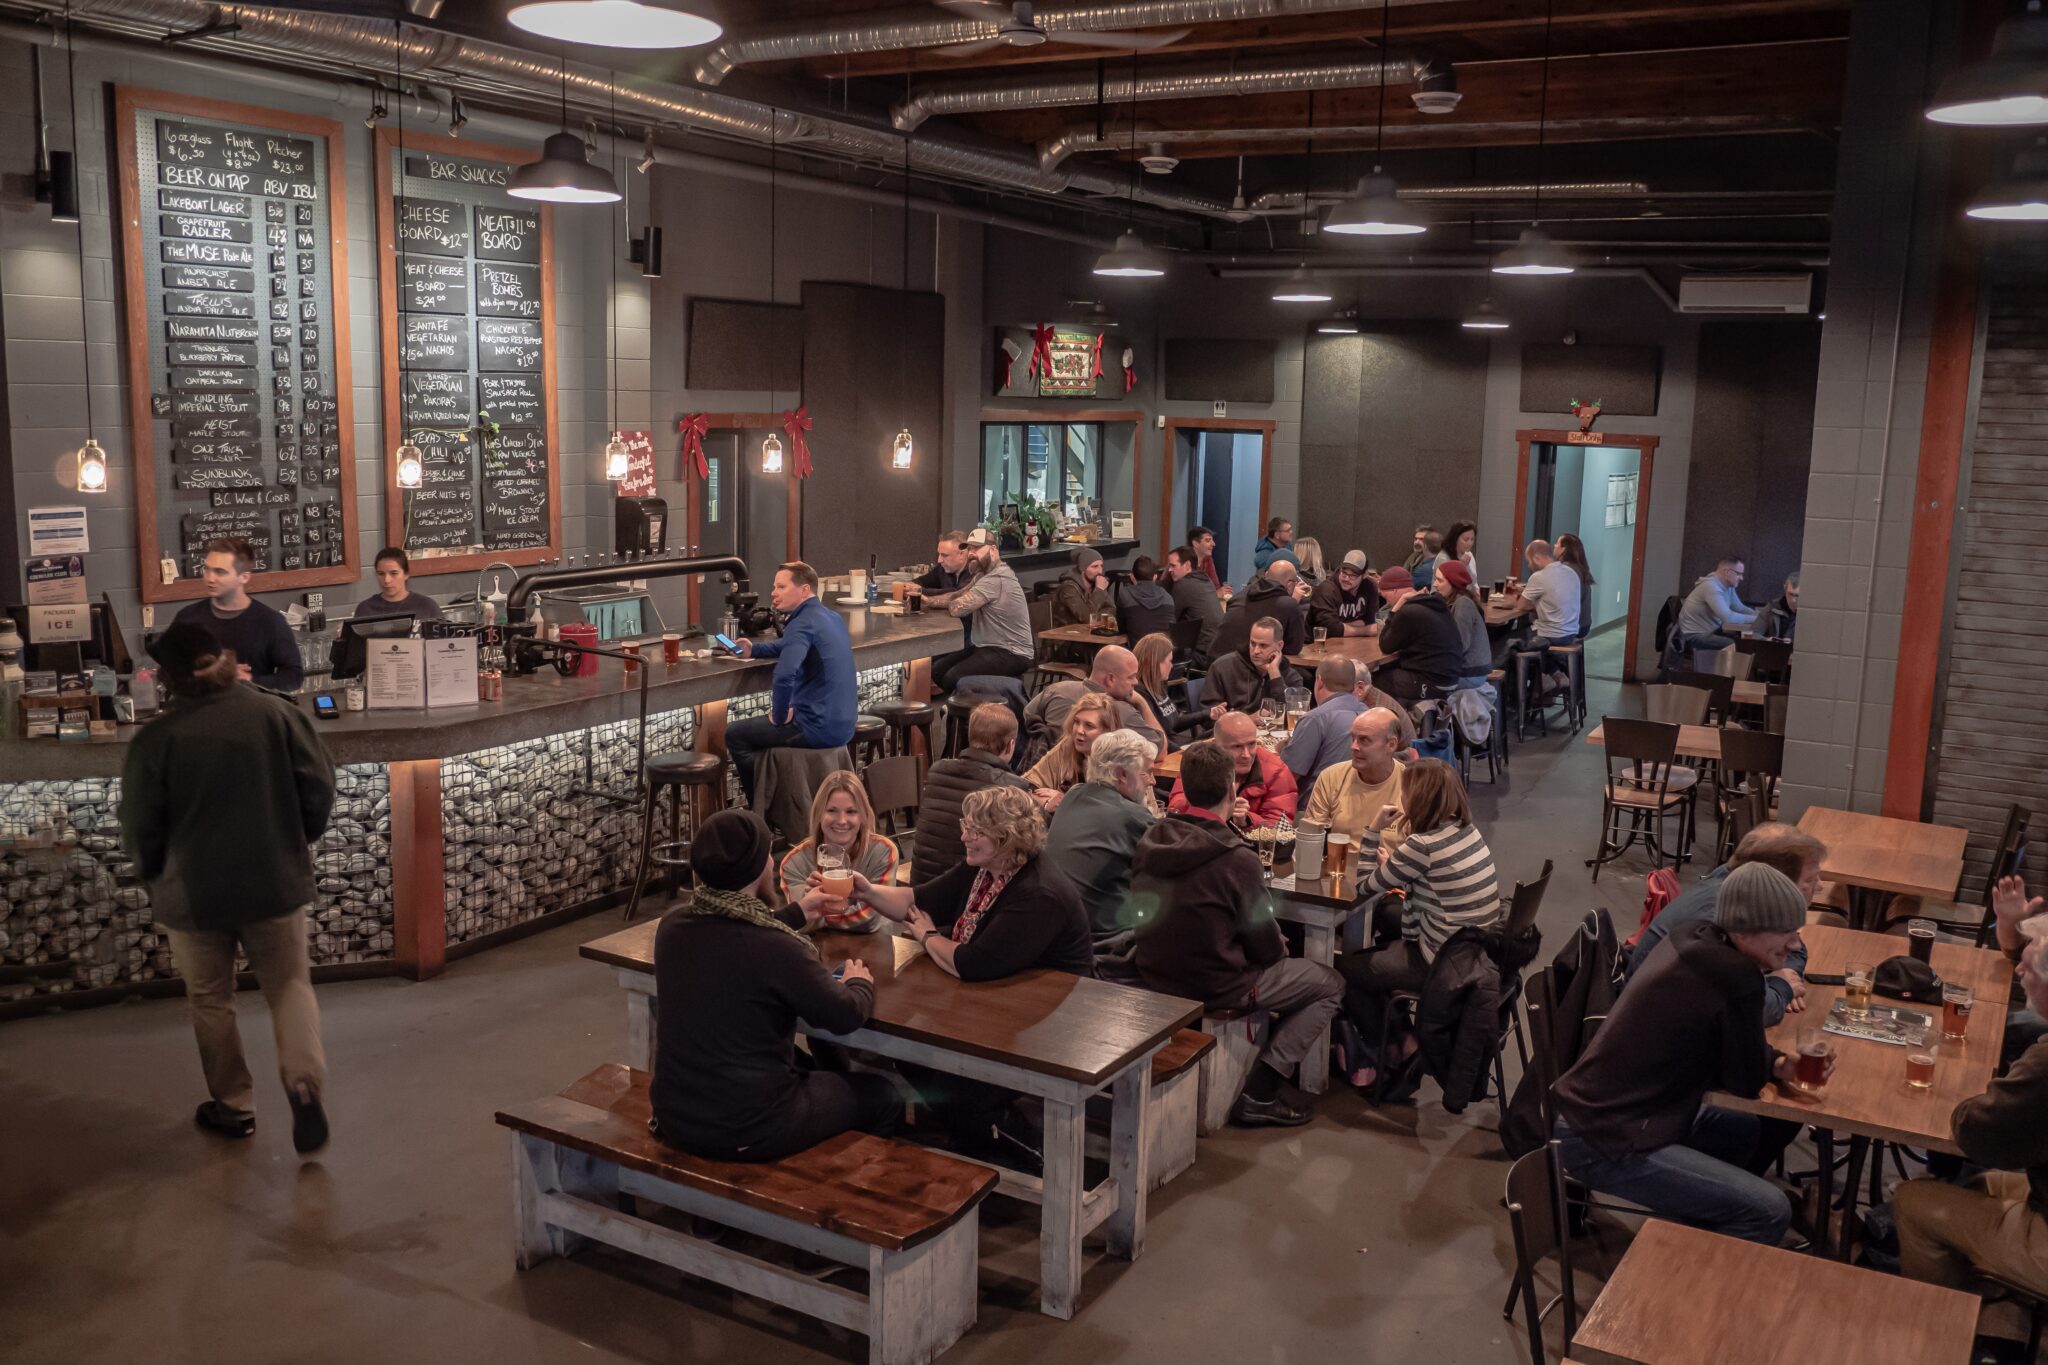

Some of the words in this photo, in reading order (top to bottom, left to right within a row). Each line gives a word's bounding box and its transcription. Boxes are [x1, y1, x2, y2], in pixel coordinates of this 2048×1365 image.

[165, 127, 176, 142] 16
[190, 134, 212, 147] glass
[225, 133, 254, 149] Flight
[267, 140, 302, 159] Pitcher
[272, 160, 304, 174] $23.00
[166, 166, 205, 186] BEER
[209, 173, 225, 188] ON
[226, 174, 249, 191] TAP
[430, 161, 456, 178] BAR
[460, 166, 506, 186] SNACKS
[264, 179, 288, 195] ABV
[292, 184, 317, 199] IBU
[161, 193, 209, 210] LAKEBOAT
[210, 197, 244, 214] LAGER
[268, 206, 283, 217] 5%
[300, 210, 311, 220] 20
[401, 205, 450, 224] CHEESE
[177, 216, 226, 228] GRAPEFRUIT
[479, 215, 513, 232] MEAT
[182, 225, 232, 240] RADLER
[269, 230, 287, 243] 4%
[299, 235, 313, 246] N/A
[399, 223, 442, 241] BOARD
[481, 231, 522, 250] BOARD
[167, 246, 185, 256] THE
[186, 243, 220, 261] MUSE
[302, 259, 312, 269] 35
[405, 264, 426, 275] MEAT
[435, 265, 464, 276] CHEESE
[482, 268, 521, 285] PRETZEL
[177, 279, 210, 288] AMBER
[216, 279, 238, 289] ALE
[416, 281, 446, 291] BOARD
[491, 283, 523, 298] BOMBS
[187, 294, 232, 307] TRELLIS
[480, 298, 491, 307] with
[177, 305, 202, 313] INDIA
[206, 307, 224, 315] PALE
[232, 307, 248, 315] ALE
[274, 303, 288, 317] 5%
[304, 303, 316, 317] 65
[170, 322, 214, 338] NARAMATA
[409, 321, 436, 332] SANTA
[486, 325, 518, 334] CHICKEN
[304, 330, 316, 339] 20
[406, 333, 457, 344] VEGETARIAN
[511, 335, 524, 343] RED
[426, 346, 455, 357] NACHOS
[496, 346, 523, 356] NACHOS
[278, 352, 289, 363] 6%
[305, 354, 316, 364] 40
[303, 377, 317, 390] 30
[412, 377, 463, 393] VEGETARIAN
[482, 379, 499, 388] PORK
[194, 394, 233, 404] KINDLING
[486, 389, 518, 398] SAUSAGE
[519, 388, 535, 397] ROLL
[306, 400, 320, 410] 60
[424, 394, 457, 408] PAKORAS
[486, 401, 497, 409] with
[179, 403, 215, 412] IMPERIAL
[220, 403, 248, 412] STOUT
[203, 419, 238, 430] HEIST
[303, 422, 315, 436] 40
[412, 431, 440, 444] TEXAS
[192, 444, 214, 454] ONE
[218, 442, 243, 455] TRICK
[280, 445, 296, 460] 6%
[304, 445, 318, 455] 35
[422, 445, 448, 460] CHILI
[498, 450, 510, 459] RAW
[190, 469, 253, 481] SUNBLINK
[280, 469, 297, 483] 5%
[181, 480, 228, 488] TROPICAL
[235, 478, 263, 487] SOUR
[492, 479, 514, 488] SALTED
[235, 493, 255, 504] WINE
[265, 490, 290, 503] CIDER
[416, 491, 437, 500] BEER
[460, 491, 471, 500] $5
[306, 506, 320, 517] $8
[414, 508, 435, 518] CHIPS
[499, 506, 516, 515] MAPLE
[519, 505, 541, 514] STOUT
[518, 514, 539, 523] CREAM
[248, 537, 269, 545] FUSE
[410, 536, 441, 546] POPCORN
[443, 531, 453, 540] DU
[453, 529, 467, 537] JOUR
[309, 552, 321, 564] $7
[47, 620, 74, 630] ICE
